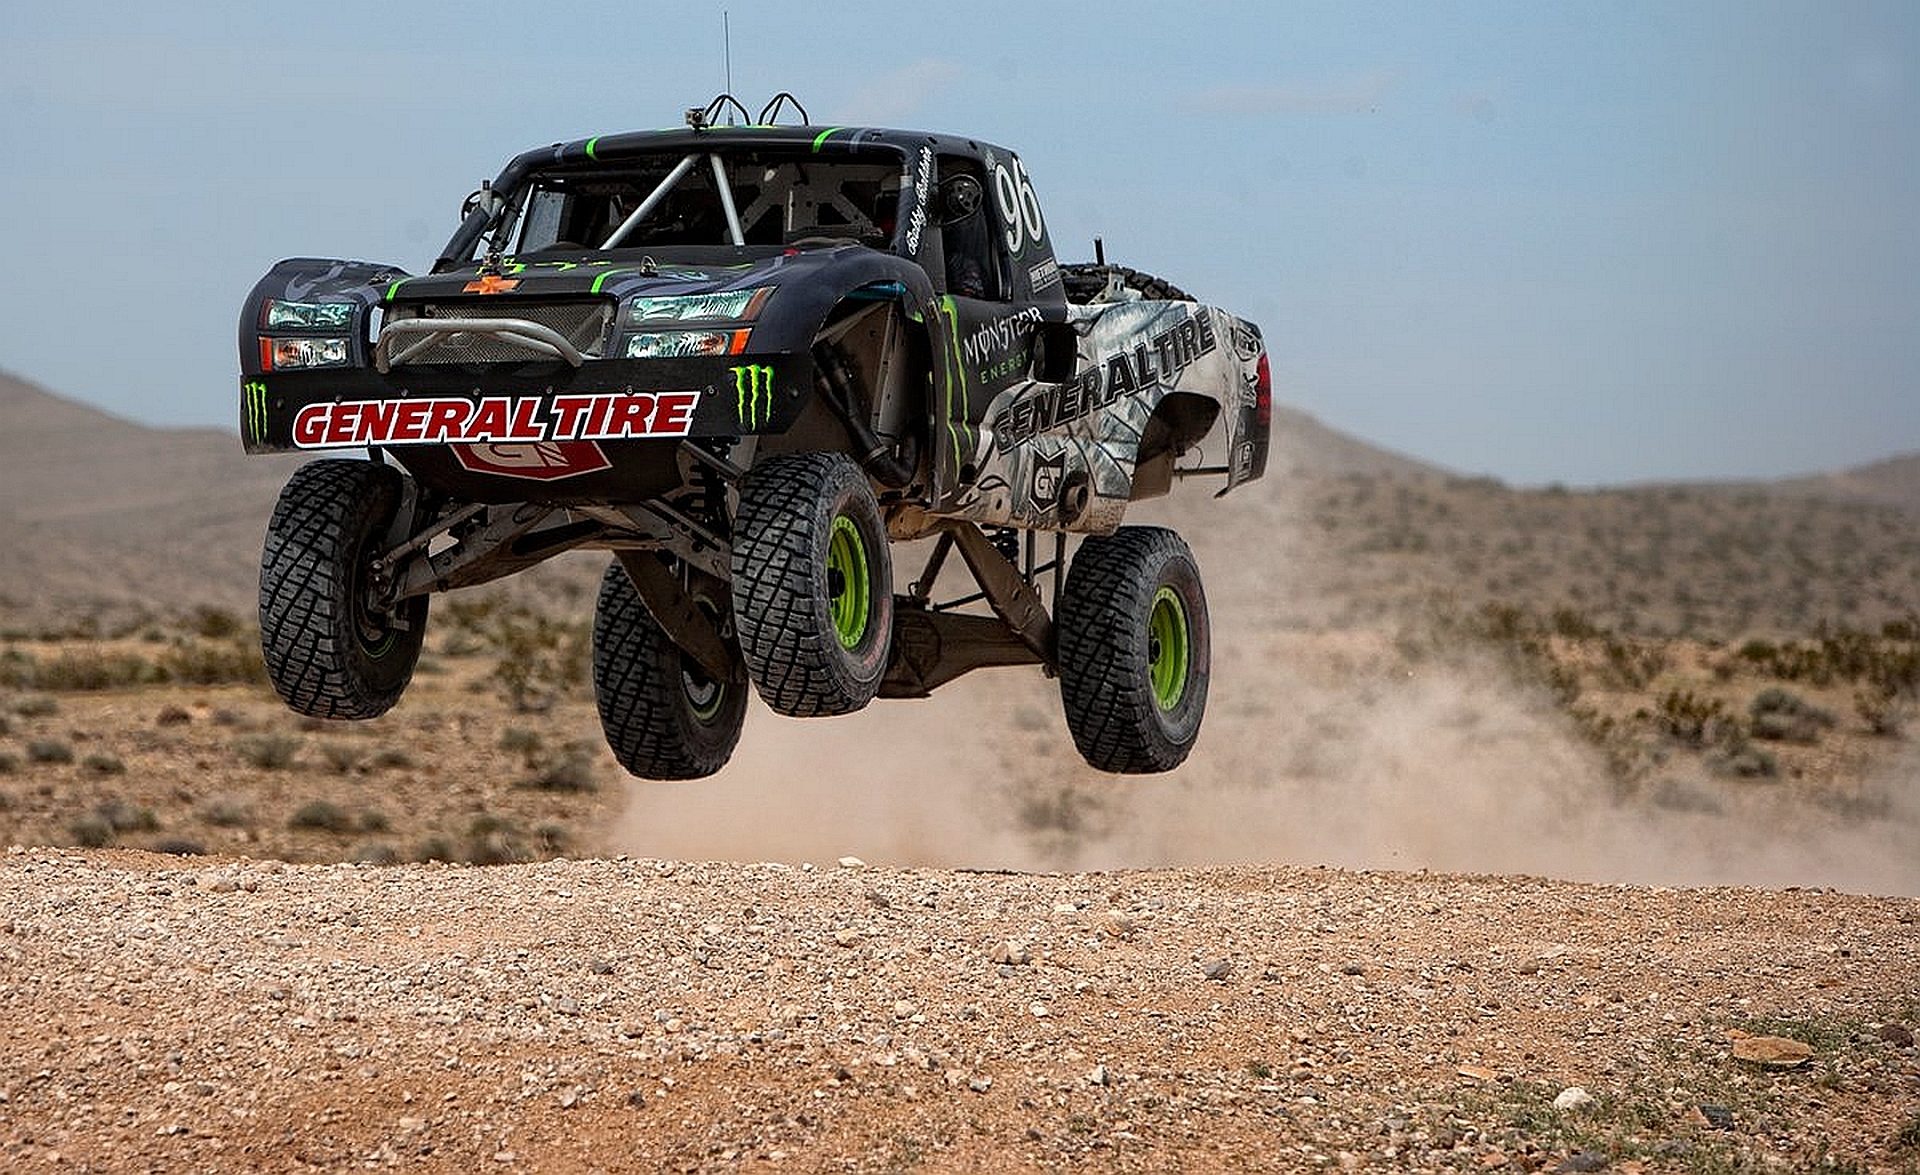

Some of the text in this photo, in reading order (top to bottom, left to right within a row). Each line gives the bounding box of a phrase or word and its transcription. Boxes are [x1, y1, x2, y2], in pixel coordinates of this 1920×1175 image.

[996, 157, 1042, 253] 96
[980, 348, 1027, 385] ENERGY
[993, 343, 1159, 455] GENERAL
[1152, 307, 1217, 379] TIRE
[292, 392, 700, 449] GENERAL TIRE
